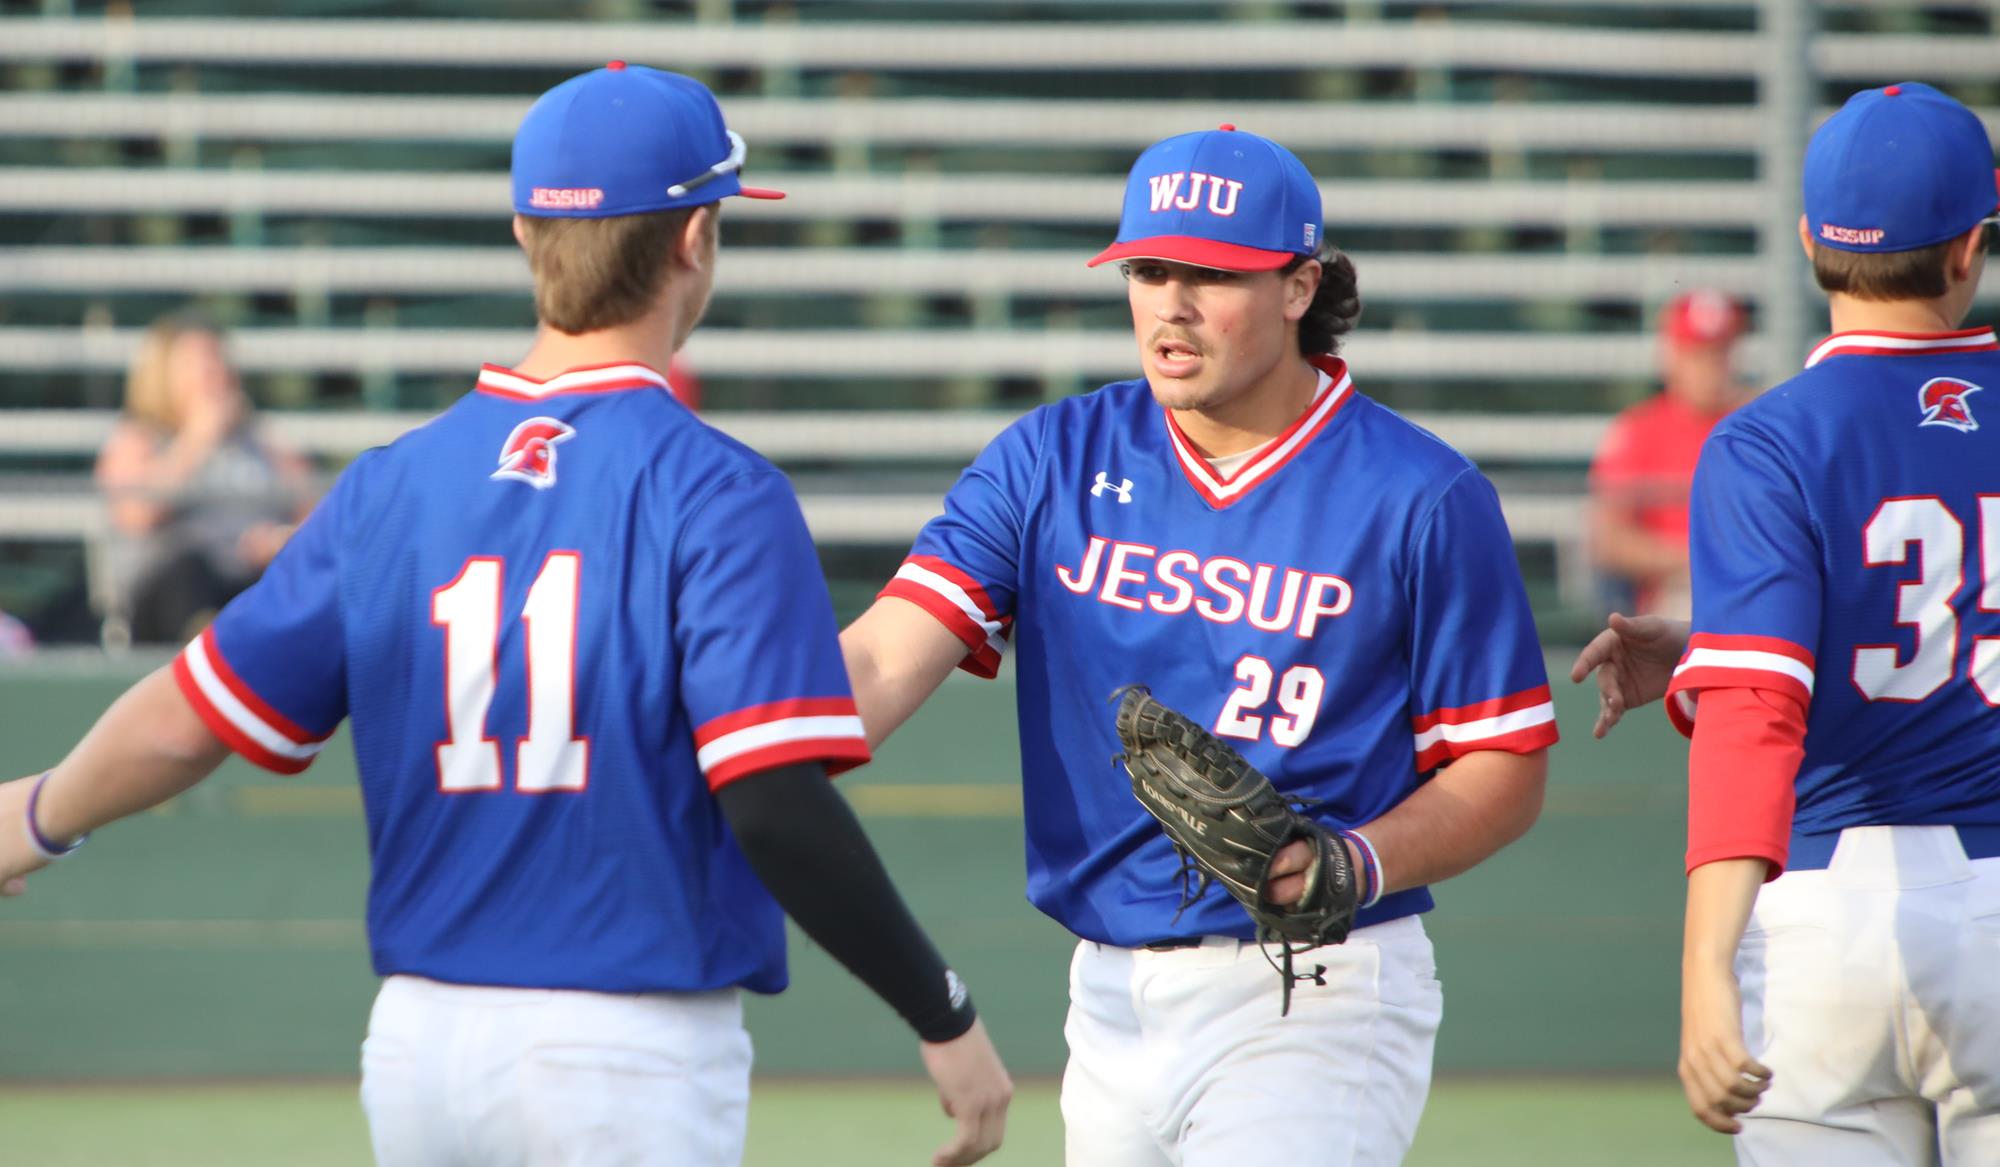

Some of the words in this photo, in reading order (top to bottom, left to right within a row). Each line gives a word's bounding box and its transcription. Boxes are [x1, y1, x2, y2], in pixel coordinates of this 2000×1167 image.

[530, 187, 603, 209] JESSUP
[1149, 171, 1243, 217] WJU
[1820, 224, 1885, 245] JESSUP
[1056, 535, 1353, 638] JESSUP
[430, 549, 589, 793] 11
[1215, 654, 1325, 748] 29
[1141, 778, 1208, 836] LOUISVILLE
